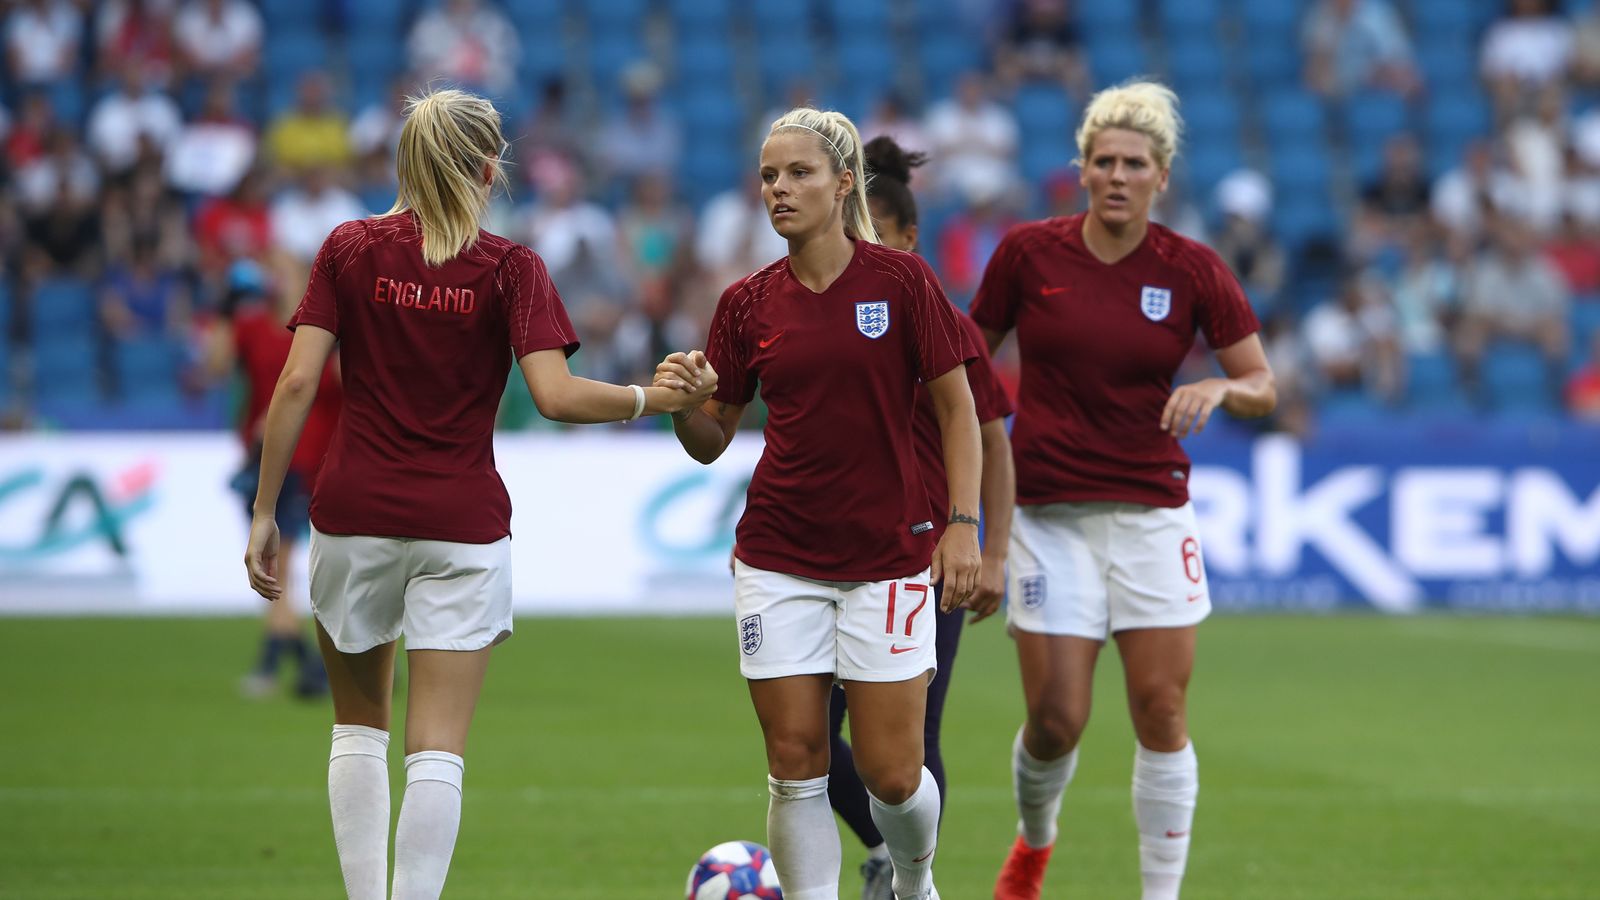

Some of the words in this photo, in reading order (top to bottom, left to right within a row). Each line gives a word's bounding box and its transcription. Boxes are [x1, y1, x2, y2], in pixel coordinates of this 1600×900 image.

[374, 276, 475, 314] ENGLAND
[1181, 536, 1202, 584] 6
[885, 581, 929, 637] 17
